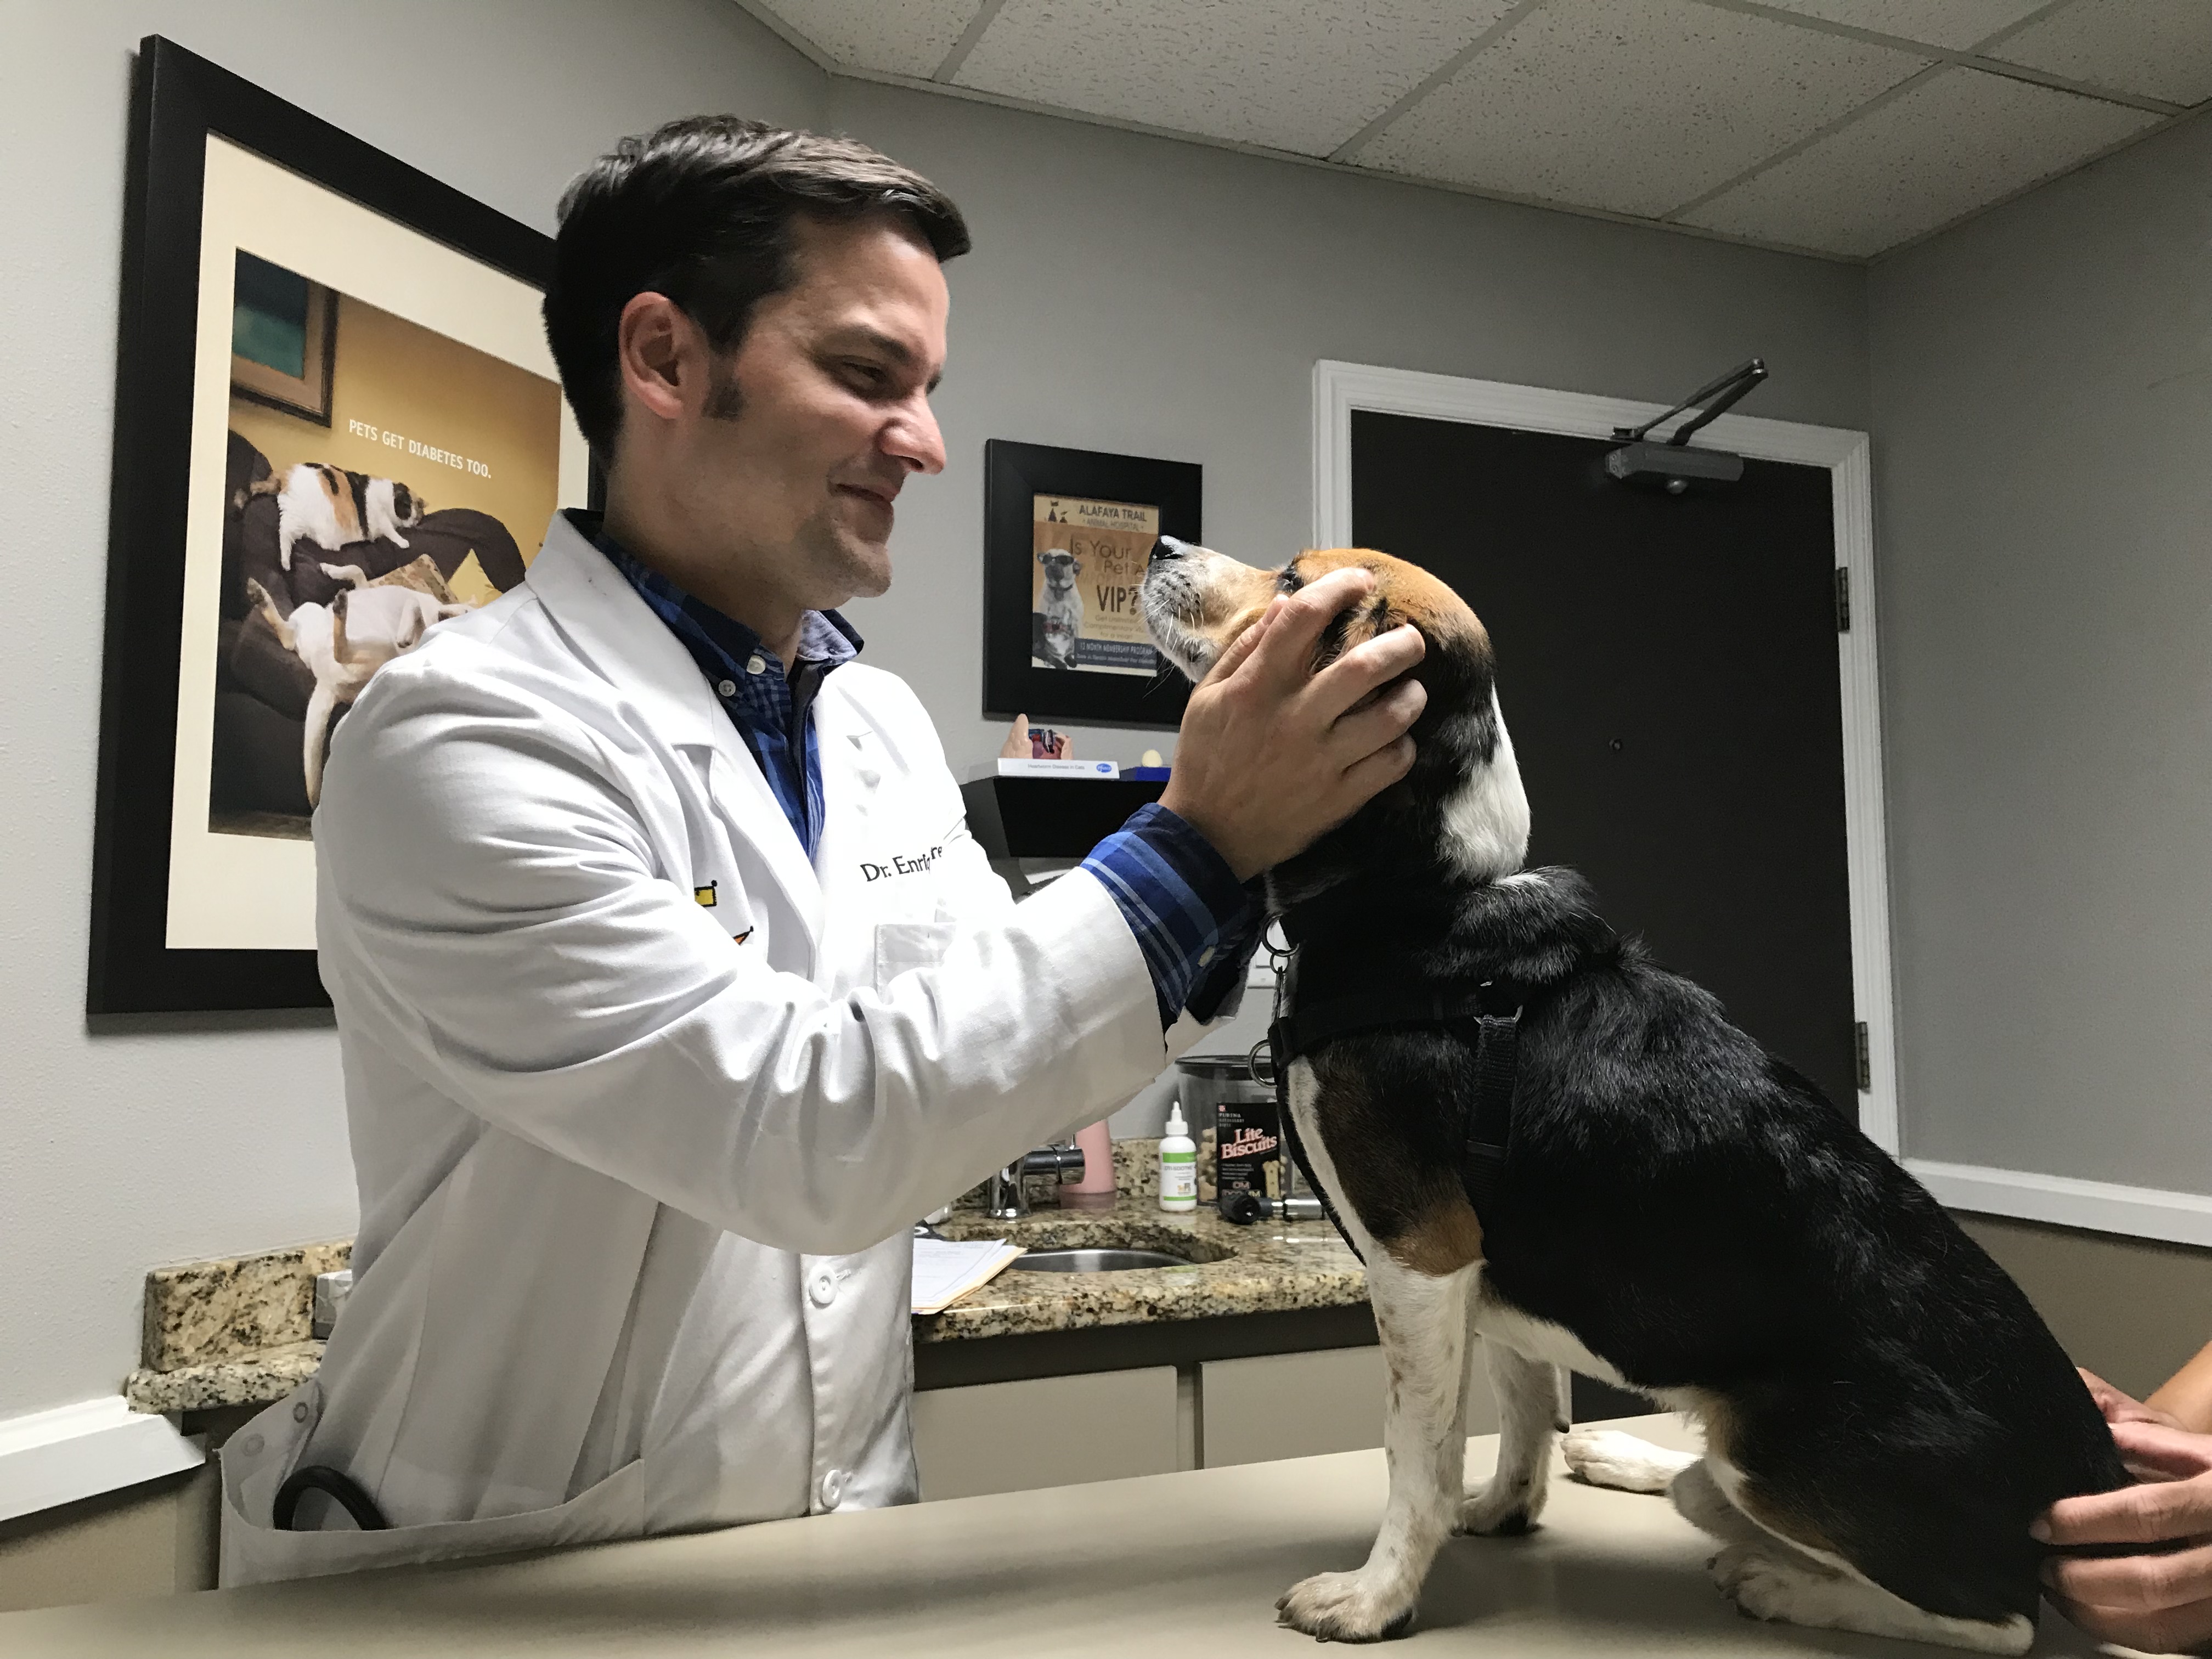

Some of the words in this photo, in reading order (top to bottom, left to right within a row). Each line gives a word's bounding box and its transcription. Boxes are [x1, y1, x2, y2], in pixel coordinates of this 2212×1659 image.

[349, 419, 378, 441] PETS
[382, 431, 405, 450] GET
[409, 439, 464, 470] DIABETES
[466, 458, 492, 479] TOO.
[1079, 505, 1120, 518] ALAFAYA
[1122, 509, 1147, 522] TRAIL
[1070, 538, 1082, 555] Is
[1104, 560, 1128, 574] Pet
[1136, 565, 1145, 575] A
[1097, 585, 1138, 616] VIP?
[860, 863, 892, 882] Dr.
[1234, 1128, 1263, 1144] Lite
[1221, 1136, 1277, 1159] Biscuits
